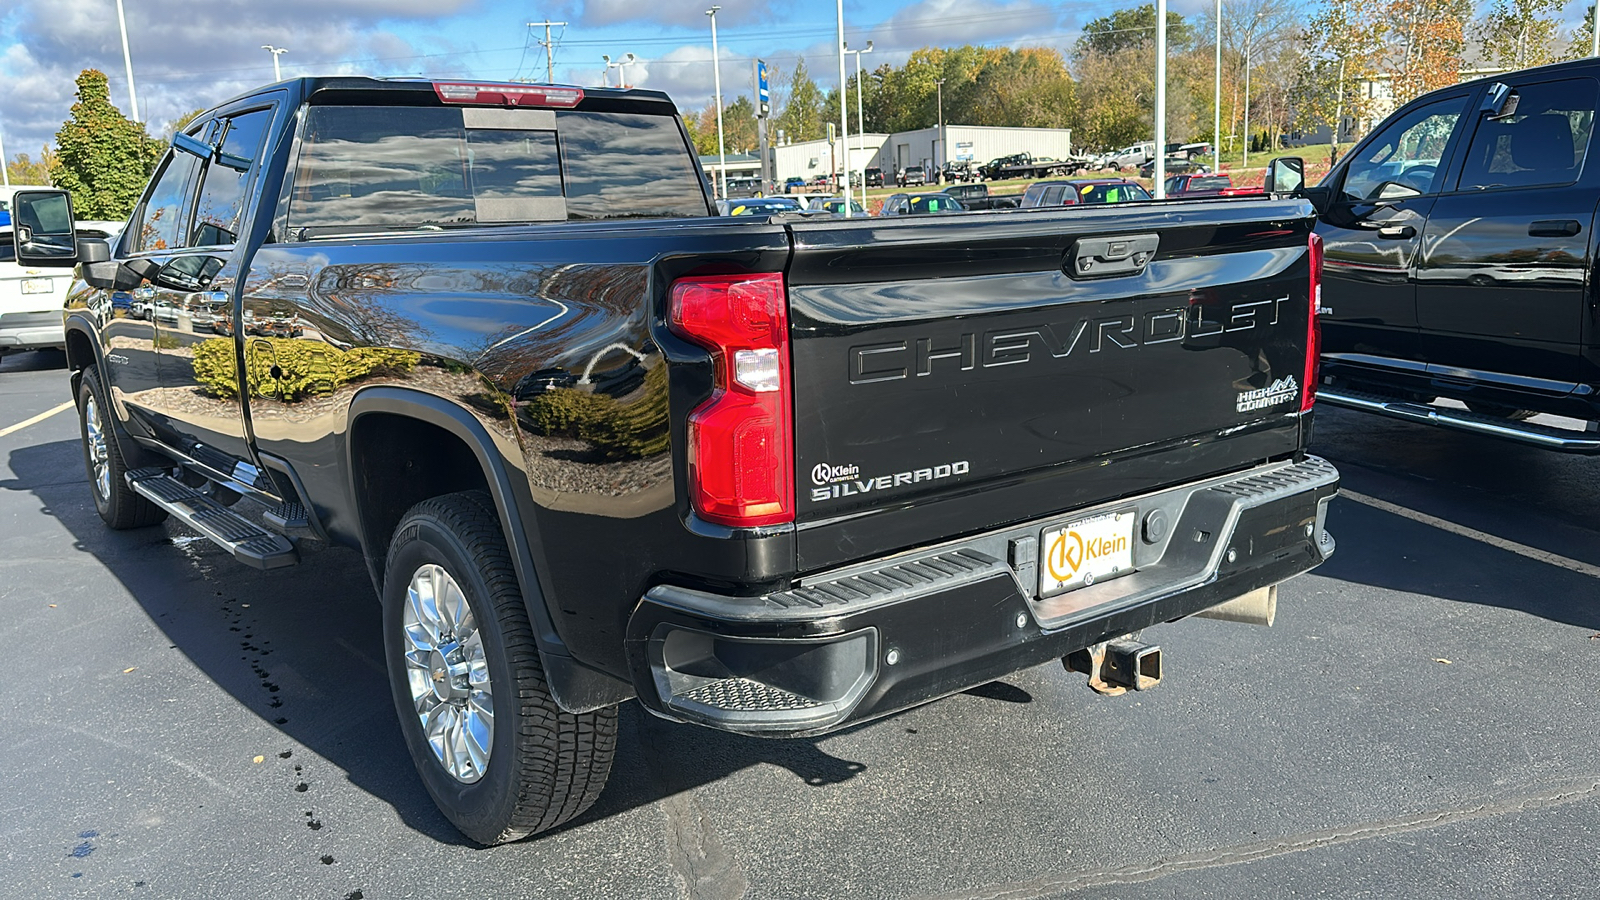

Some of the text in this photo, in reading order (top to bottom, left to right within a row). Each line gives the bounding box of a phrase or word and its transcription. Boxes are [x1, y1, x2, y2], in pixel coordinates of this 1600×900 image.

[848, 293, 1289, 385] CHEVROLET
[1236, 391, 1298, 413] COUNTRY
[1237, 388, 1271, 403] HIGH
[810, 460, 970, 502] SILVERADO
[832, 463, 859, 478] Klein
[1086, 533, 1126, 560] Klein
